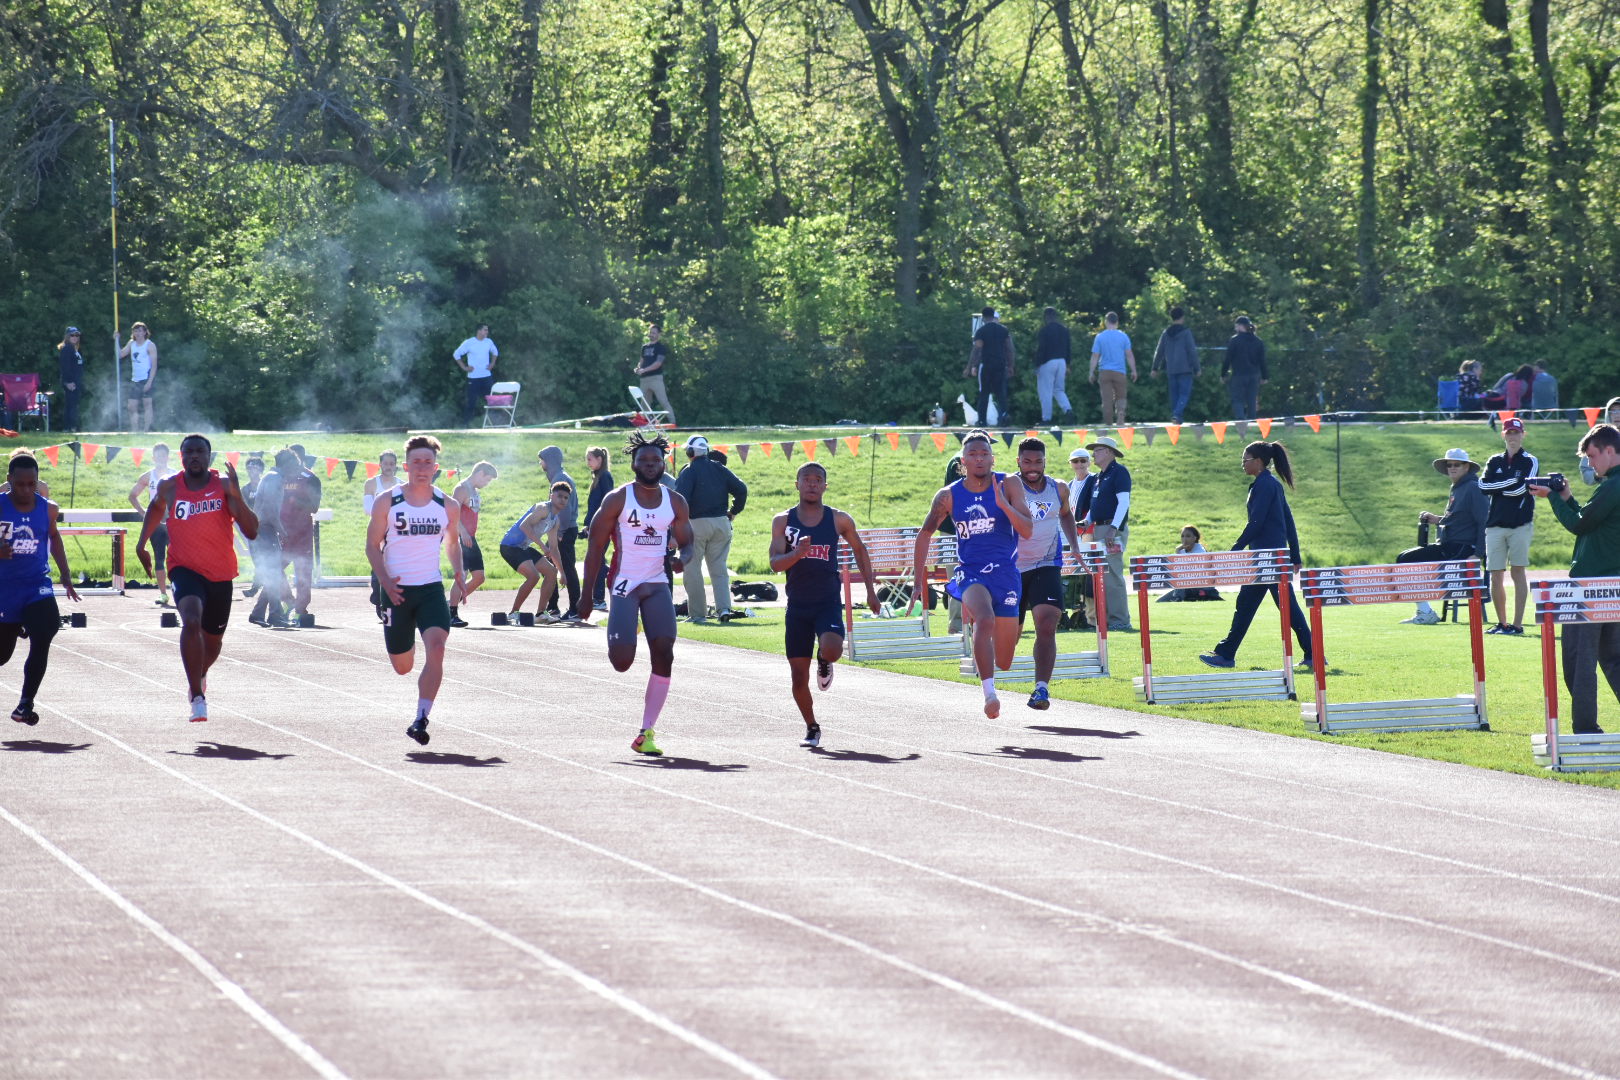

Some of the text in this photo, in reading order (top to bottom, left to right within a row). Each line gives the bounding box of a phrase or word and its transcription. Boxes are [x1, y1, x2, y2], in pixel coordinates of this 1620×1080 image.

[176, 502, 186, 519] 6
[190, 498, 222, 515] OJANS
[394, 512, 407, 530] 5
[628, 509, 641, 527] 4
[968, 518, 996, 530] CBC
[0, 523, 11, 537] 7
[785, 528, 798, 544] 3
[957, 522, 967, 538] 2
[12, 540, 39, 550] CBC
[615, 580, 628, 598] 4
[1402, 592, 1440, 600] UNIVERSITY
